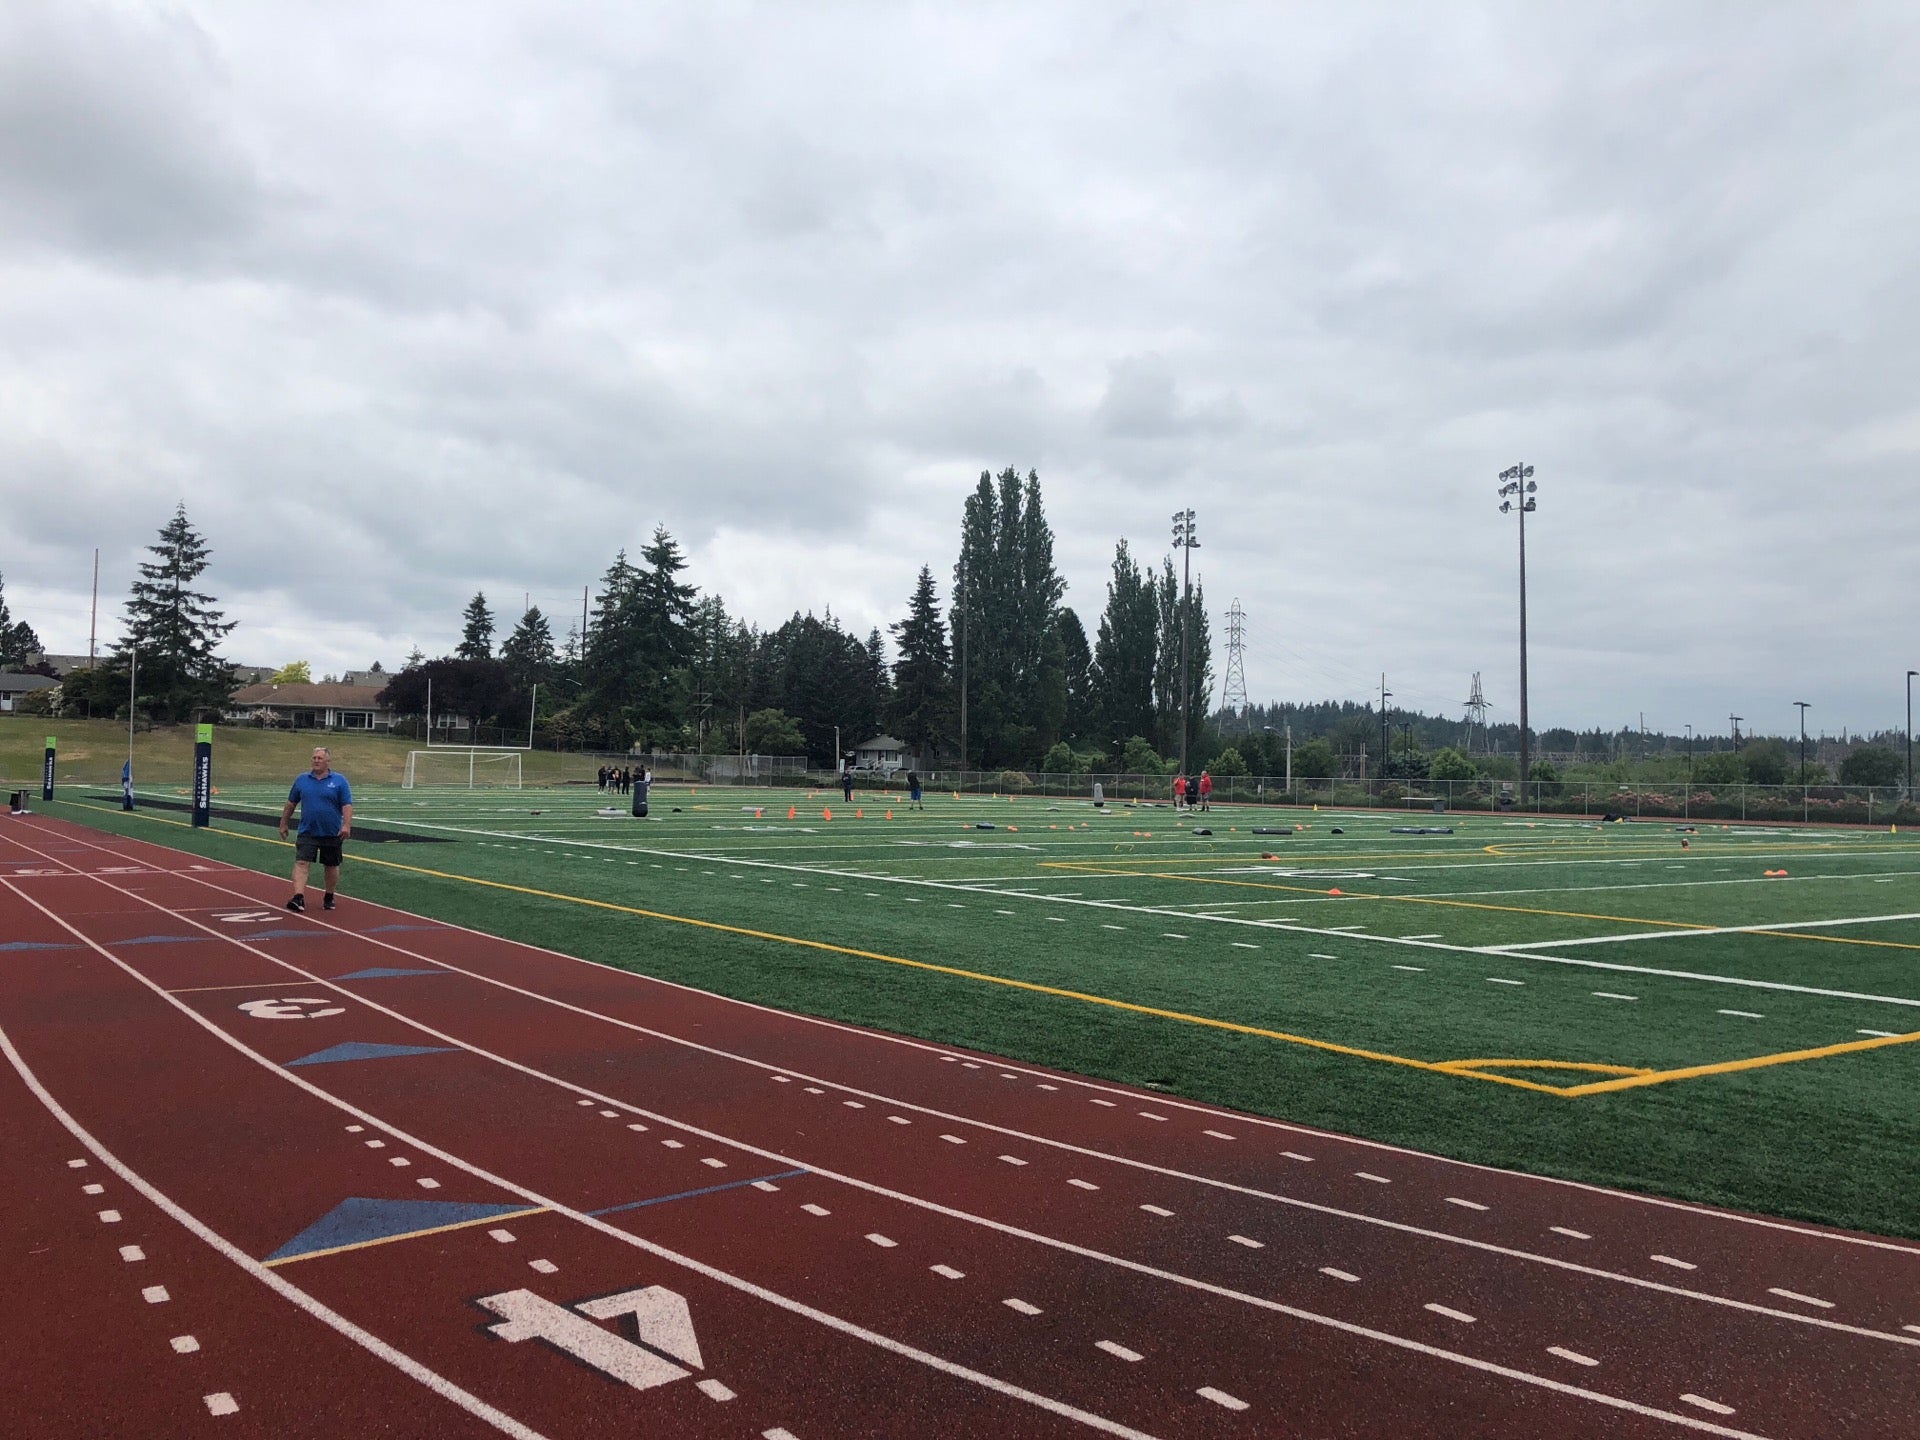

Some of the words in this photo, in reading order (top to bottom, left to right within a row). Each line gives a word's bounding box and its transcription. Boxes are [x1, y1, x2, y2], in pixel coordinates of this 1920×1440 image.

[199, 756, 209, 809] SEAHAWKS
[237, 998, 346, 1019] 3
[472, 1285, 704, 1391] 4
